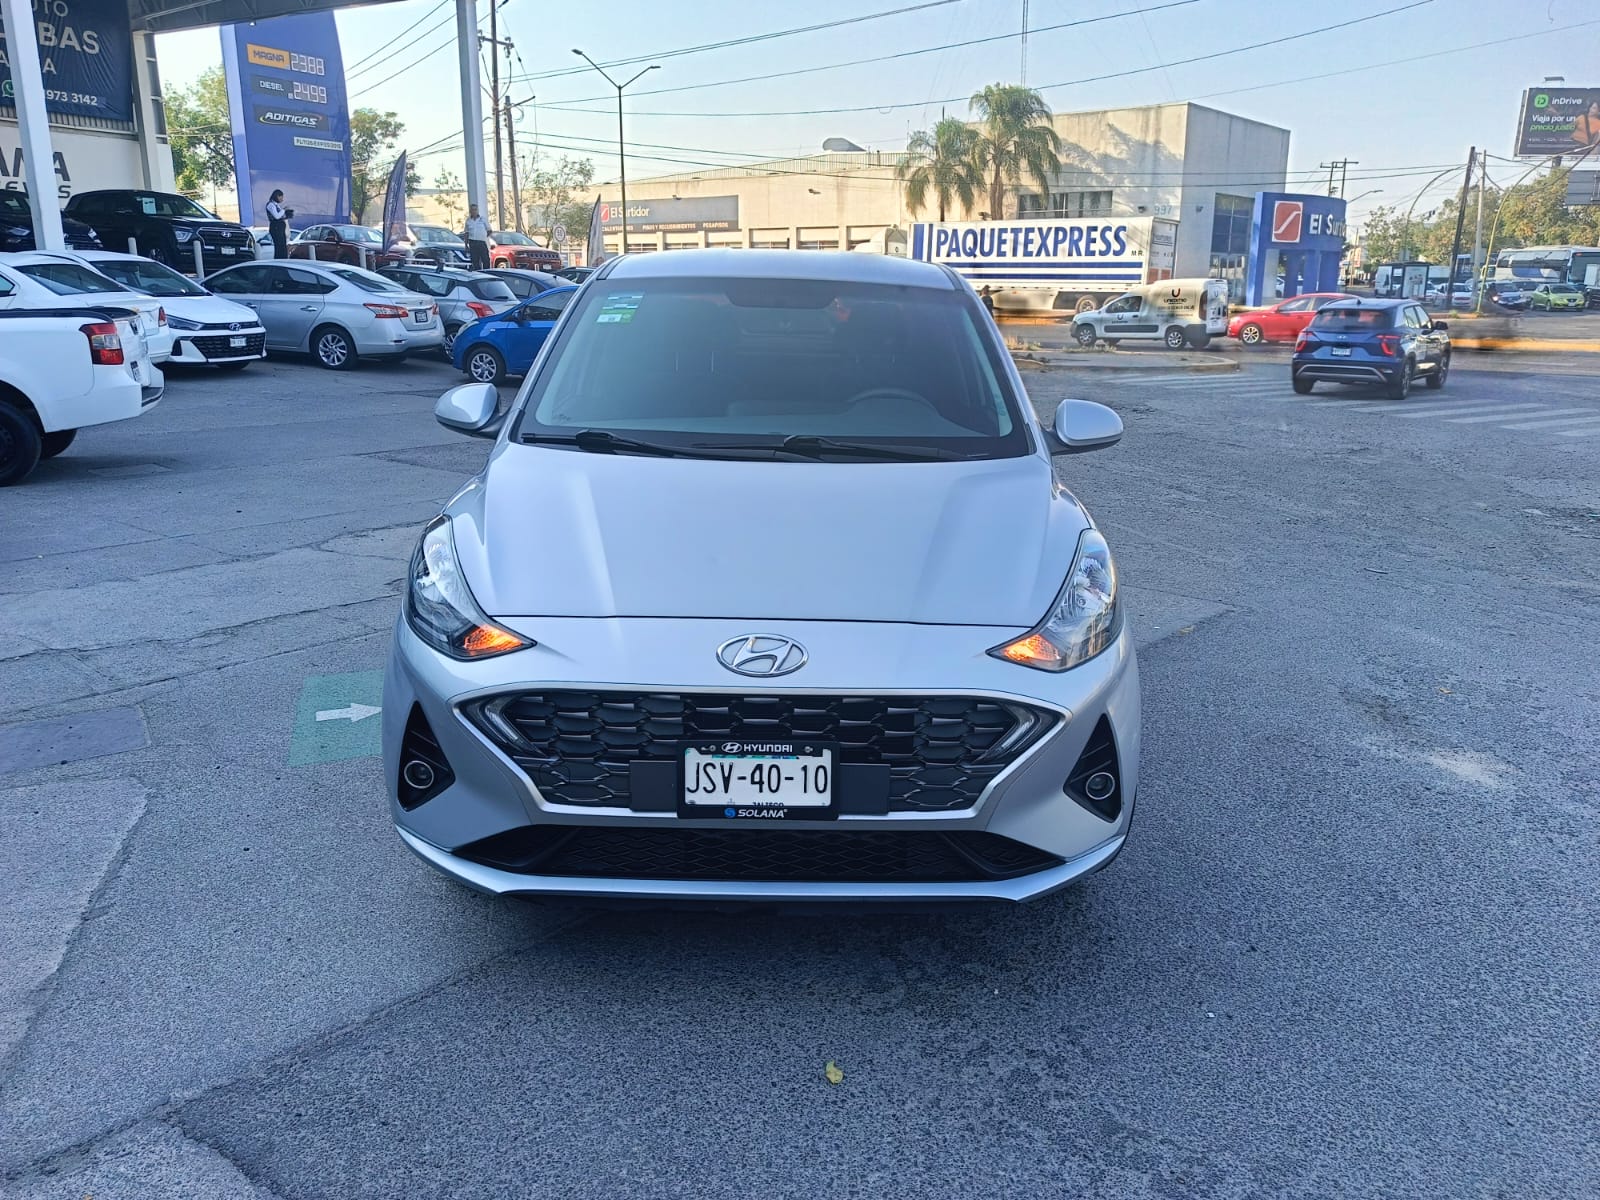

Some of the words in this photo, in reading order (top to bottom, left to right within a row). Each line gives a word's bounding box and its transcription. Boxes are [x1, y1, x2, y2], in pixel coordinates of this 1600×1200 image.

[259, 80, 285, 92] DIESEL
[71, 93, 98, 106] 3142
[1552, 97, 1582, 105] inDrive
[264, 111, 318, 126] ADITIGAS
[1531, 114, 1550, 124] Viaja
[1550, 116, 1565, 124] por
[610, 207, 619, 218] El
[1310, 214, 1322, 234] El
[935, 225, 1127, 258] PAQUETEXPRESS
[743, 744, 793, 753] HYUNDAI
[686, 761, 828, 794] JSV-40-10
[737, 808, 785, 819] SOLANA
